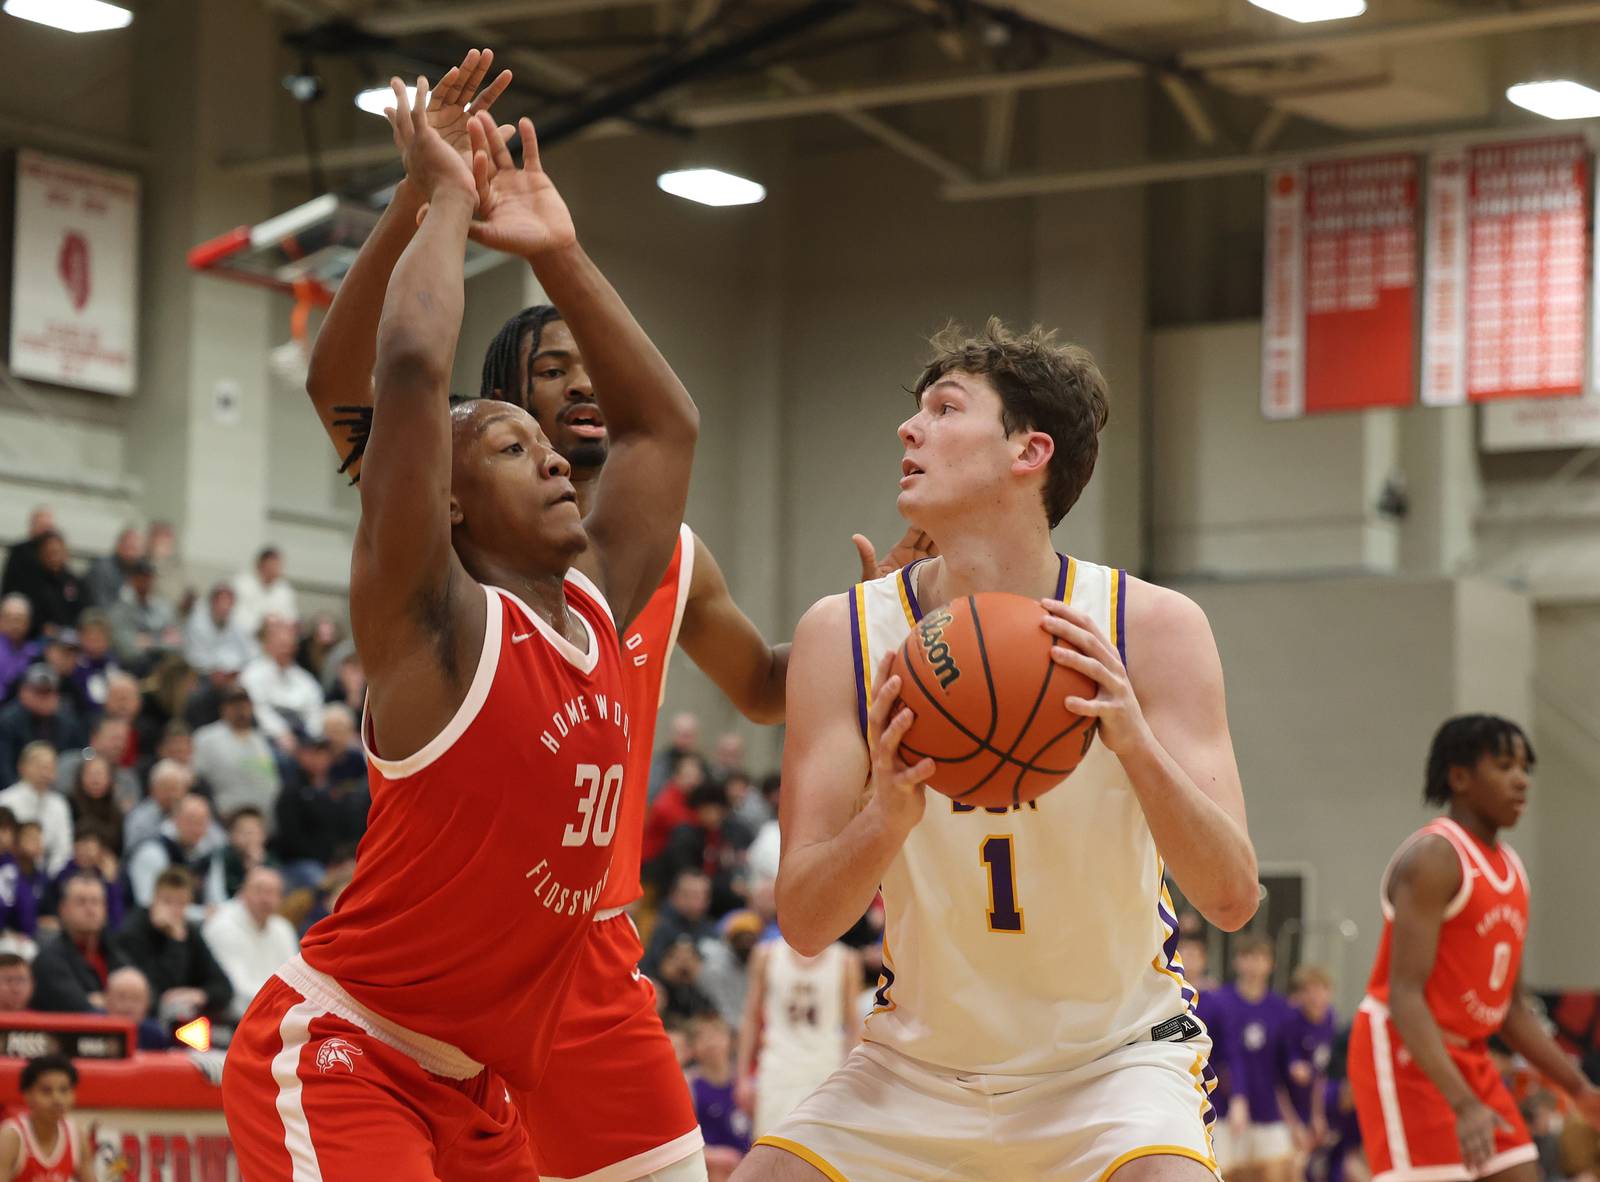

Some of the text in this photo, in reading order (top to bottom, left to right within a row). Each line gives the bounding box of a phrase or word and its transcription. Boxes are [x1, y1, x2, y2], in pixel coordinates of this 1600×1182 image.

[540, 694, 630, 753] HOMEWOO
[562, 764, 623, 847] 30
[526, 857, 613, 915] FLOSSMOO
[979, 834, 1025, 934] 1
[1181, 1020, 1194, 1031] XL
